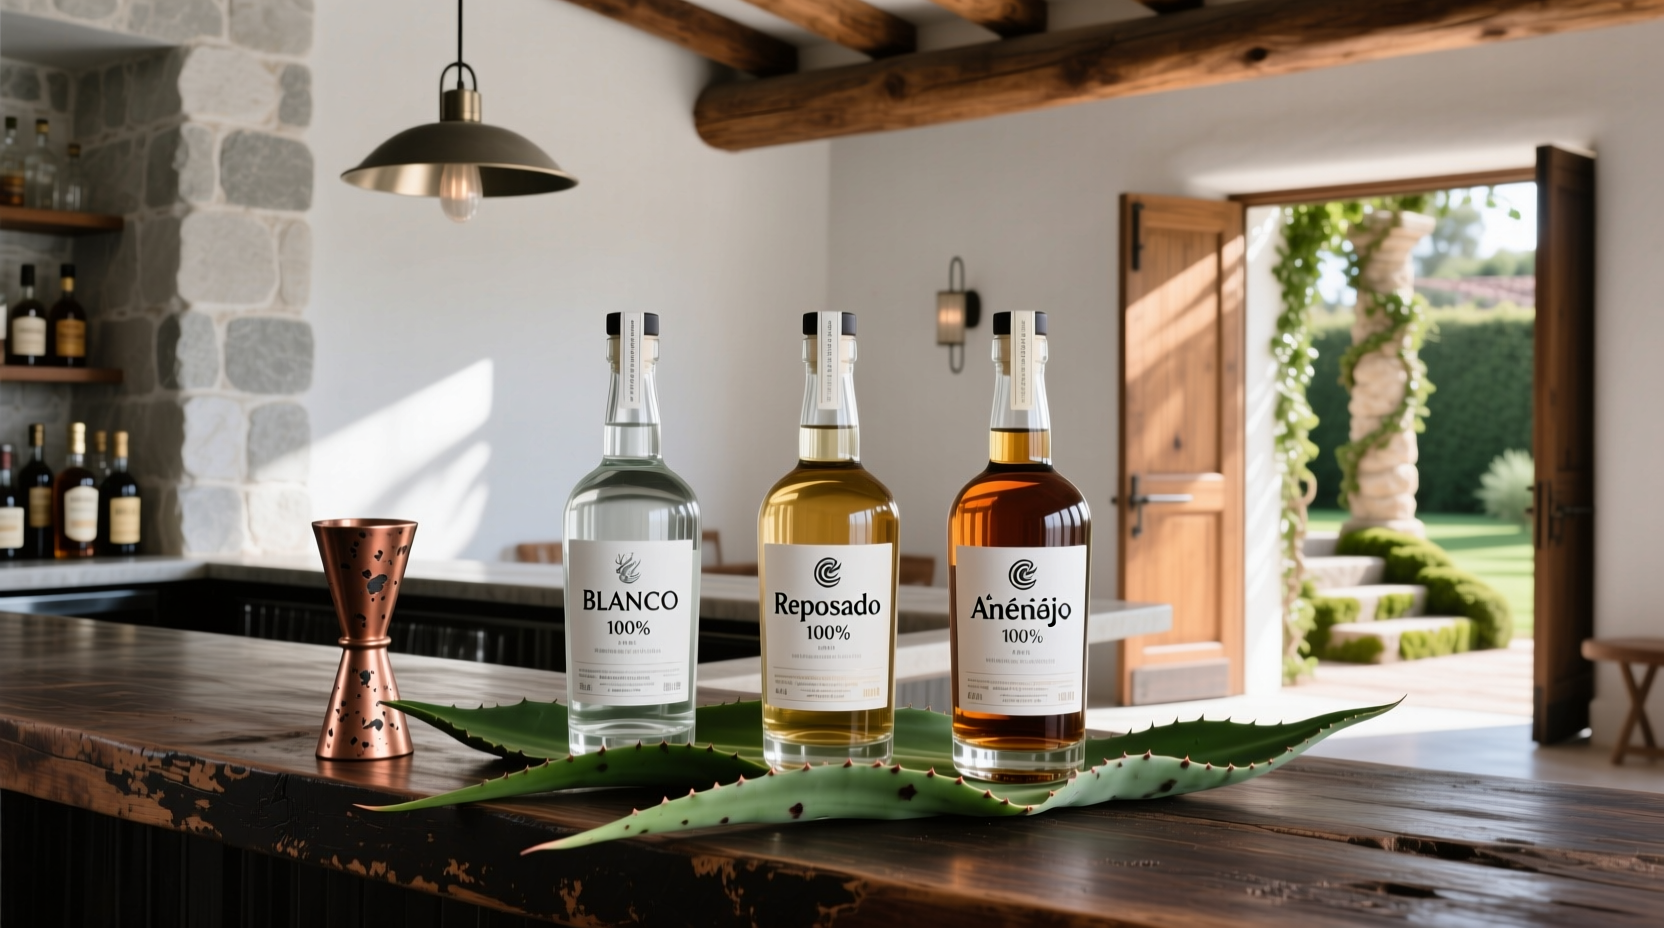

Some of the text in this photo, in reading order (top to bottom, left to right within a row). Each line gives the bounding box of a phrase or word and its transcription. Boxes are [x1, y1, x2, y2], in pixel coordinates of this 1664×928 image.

[583, 589, 679, 611] BLANCO
[774, 592, 881, 622] Reposado
[607, 620, 651, 635] 100%
[806, 624, 851, 640] 100%
[1002, 628, 1044, 643] 100%
